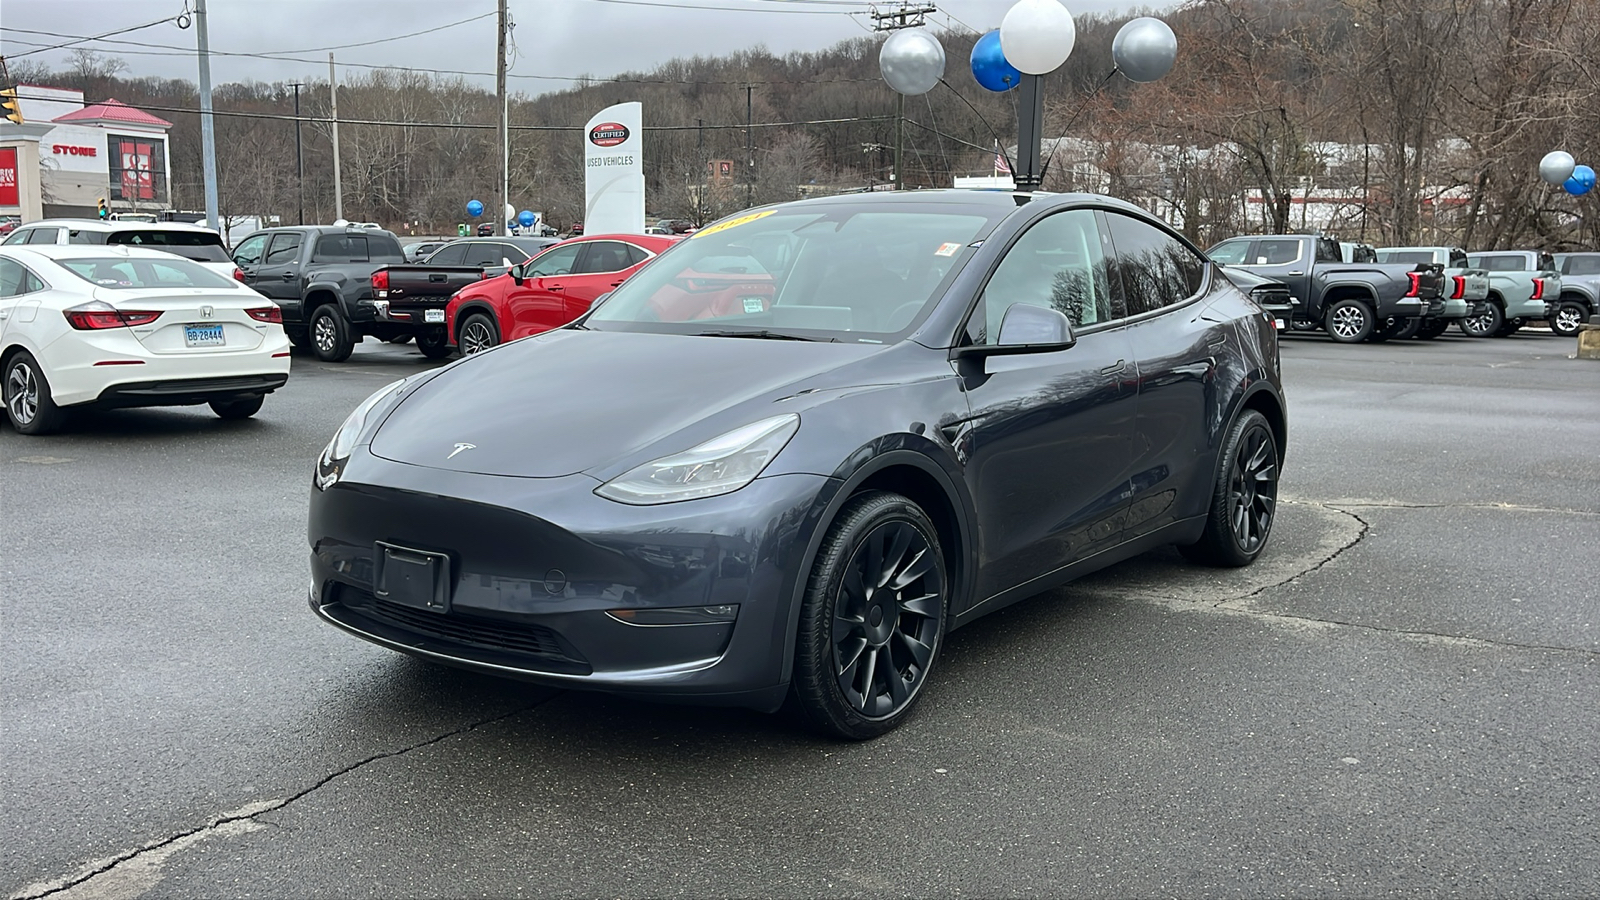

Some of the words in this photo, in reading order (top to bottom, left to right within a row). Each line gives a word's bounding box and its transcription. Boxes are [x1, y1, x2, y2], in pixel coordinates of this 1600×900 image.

[593, 131, 625, 139] CERTIFIED
[53, 145, 96, 157] STONE
[587, 157, 602, 167] USED
[603, 155, 634, 166] VEHICLES
